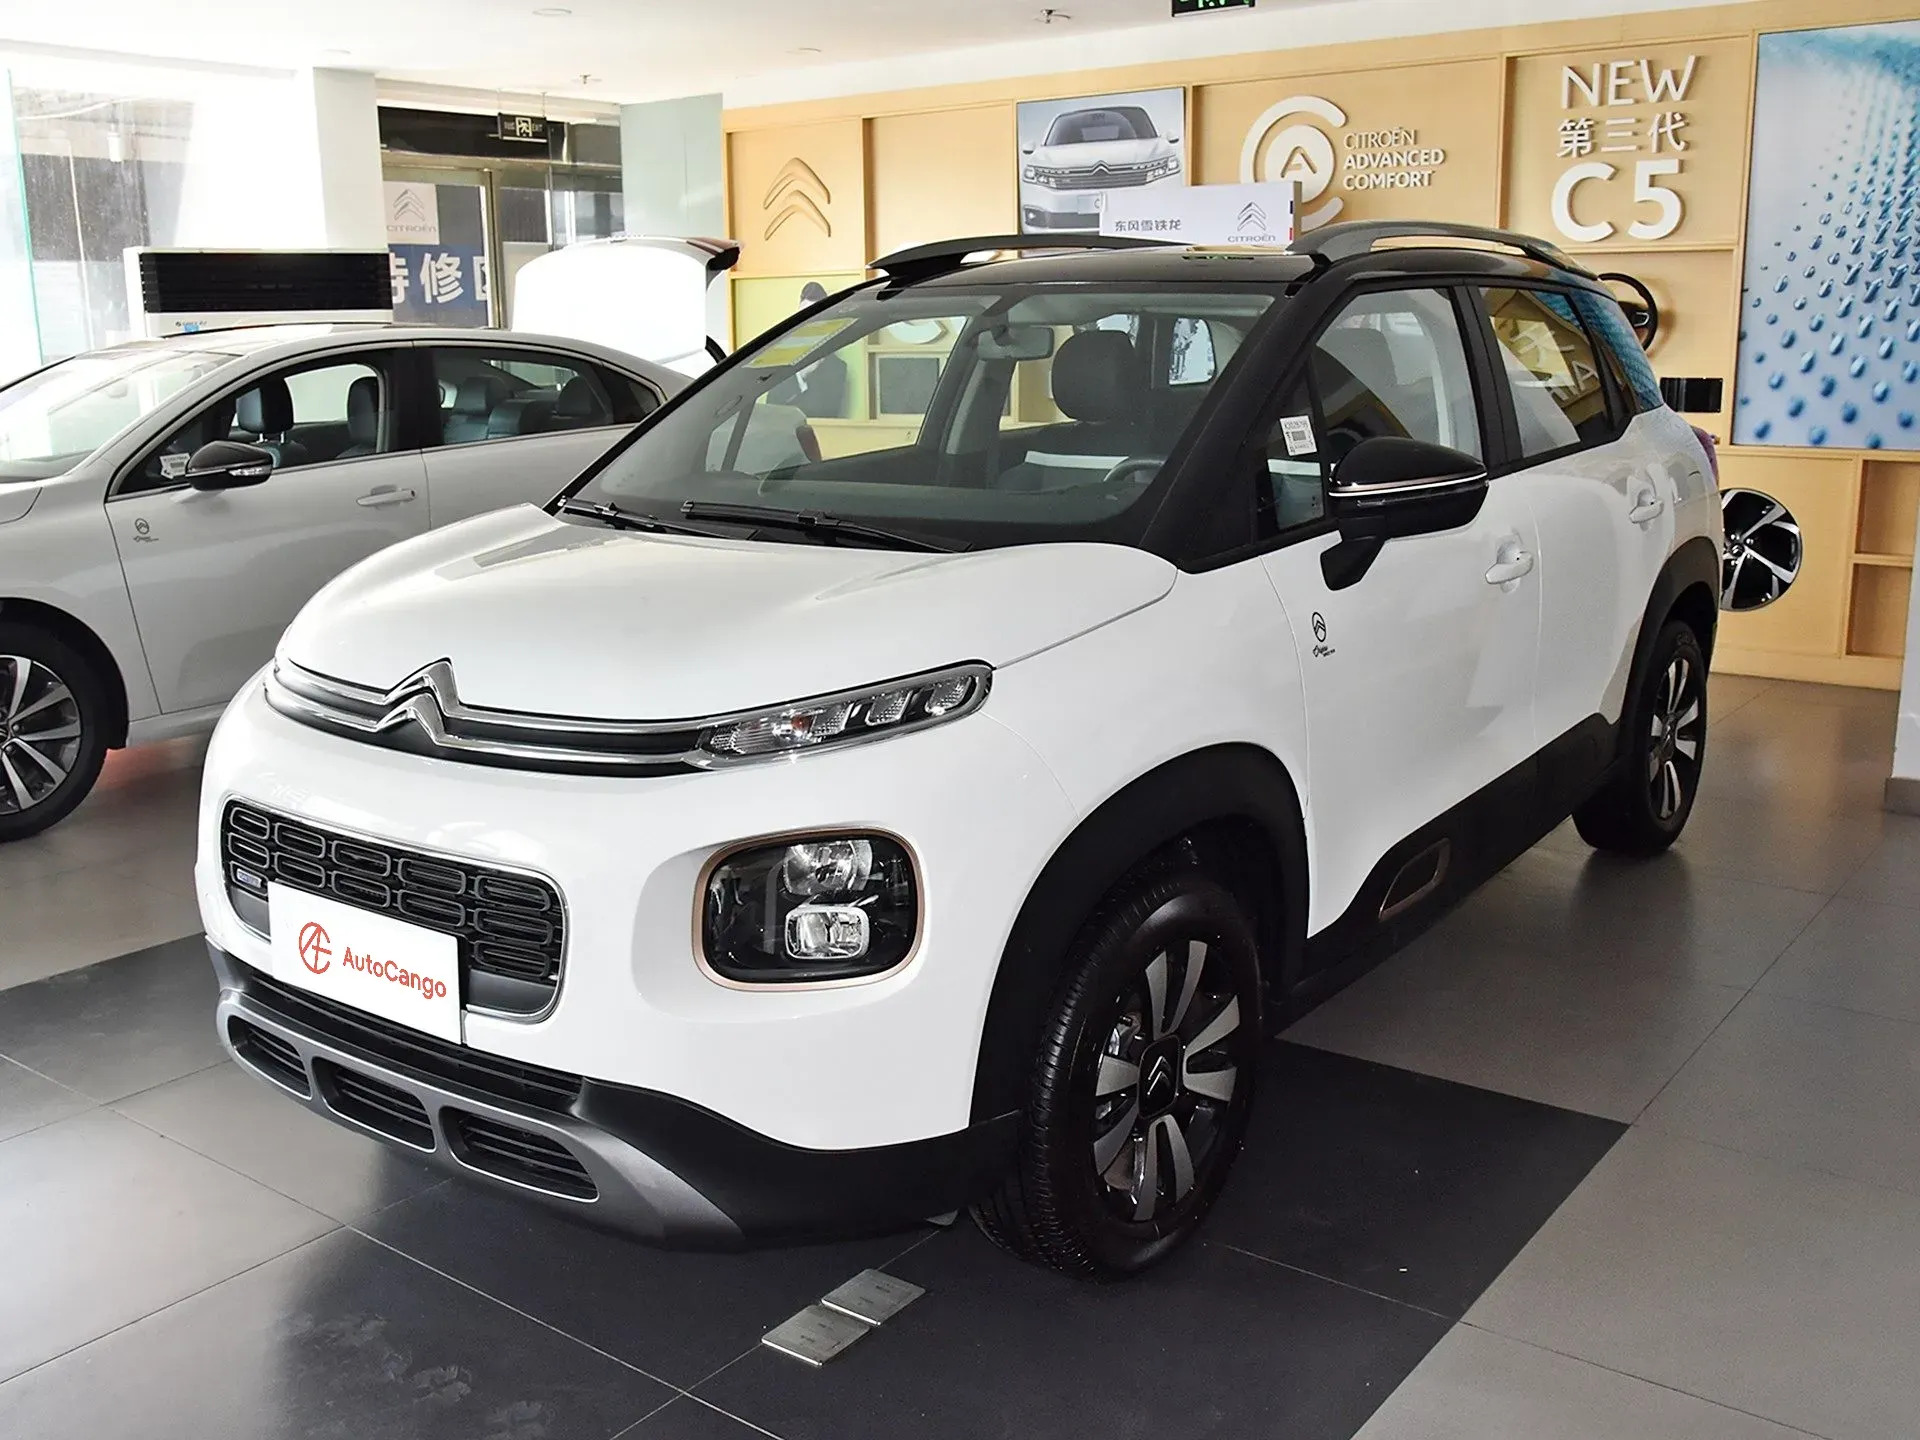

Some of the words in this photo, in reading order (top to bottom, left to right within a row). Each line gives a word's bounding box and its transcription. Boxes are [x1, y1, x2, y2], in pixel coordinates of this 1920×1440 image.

[1561, 55, 1696, 109] NEW
[1556, 111, 1687, 158] 第三代
[1343, 148, 1446, 171] ADVANCED
[1343, 170, 1434, 191] COMFORT
[1551, 158, 1683, 243] C5
[1115, 219, 1182, 232] 东风雪铁龙
